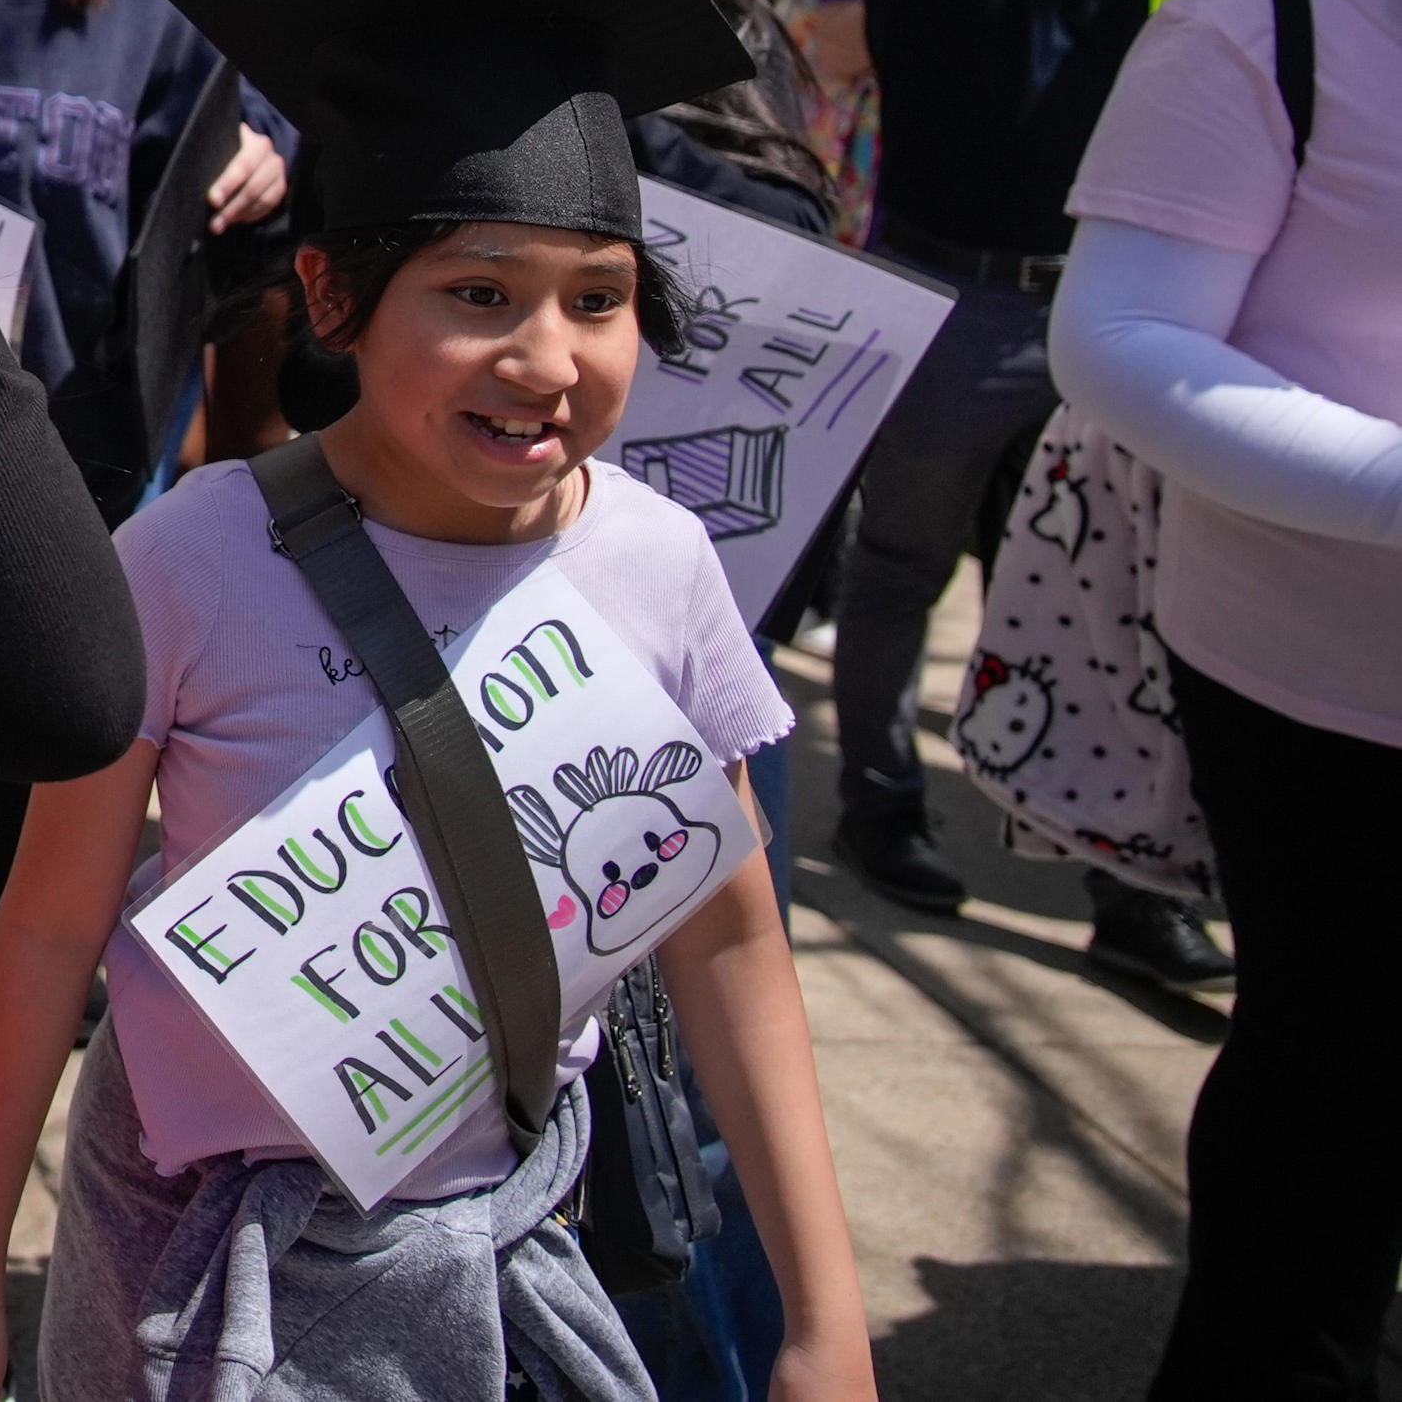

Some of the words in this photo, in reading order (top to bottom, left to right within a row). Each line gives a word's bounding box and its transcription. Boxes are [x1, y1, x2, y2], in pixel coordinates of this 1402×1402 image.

[657, 285, 760, 385] FOR
[738, 308, 853, 414] ALL
[294, 886, 456, 1022] FOR
[333, 987, 487, 1135] ALL
